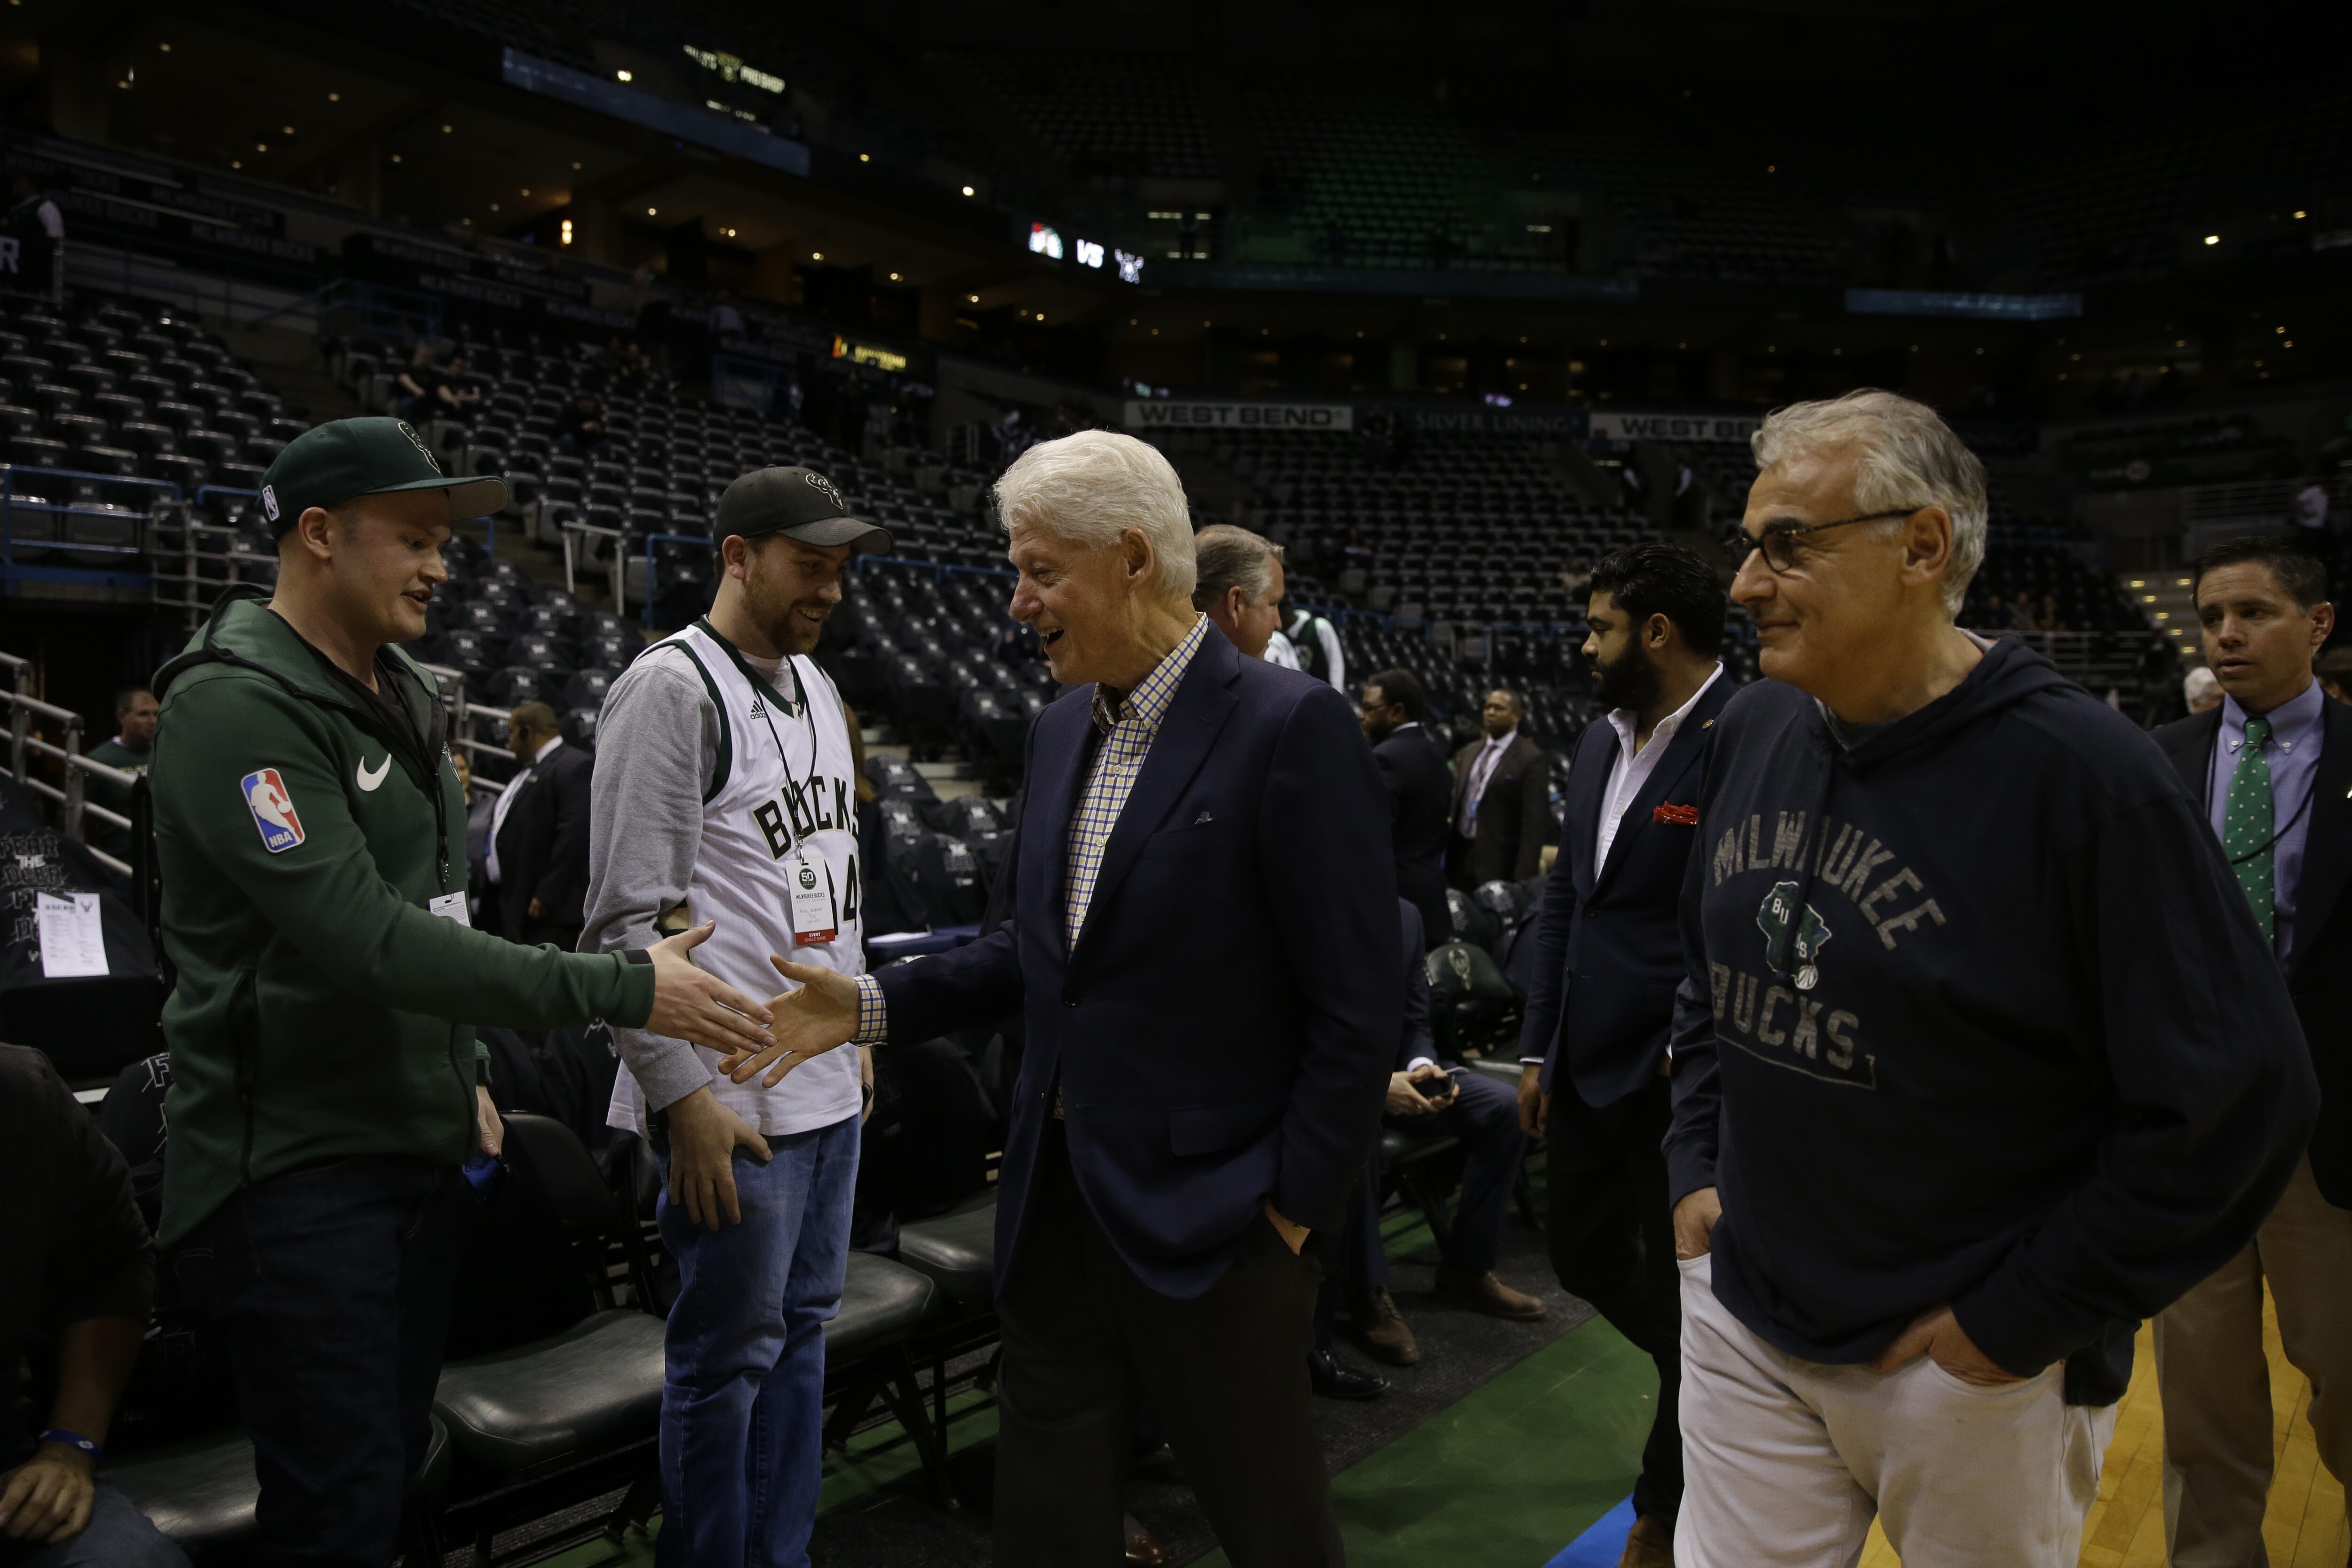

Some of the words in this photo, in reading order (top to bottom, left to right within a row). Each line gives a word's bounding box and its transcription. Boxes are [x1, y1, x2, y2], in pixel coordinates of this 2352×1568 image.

[1076, 239, 1104, 268] VS
[1139, 405, 1232, 422] WEST
[1240, 407, 1331, 425] BEND
[1415, 412, 1483, 431] SILVER
[1622, 419, 1708, 436] WEST
[269, 831, 293, 848] NBA
[15, 854, 46, 869] THE
[801, 871, 814, 882] 50
[1772, 897, 1808, 958] BUS
[1710, 961, 1859, 1070] BUCKS
